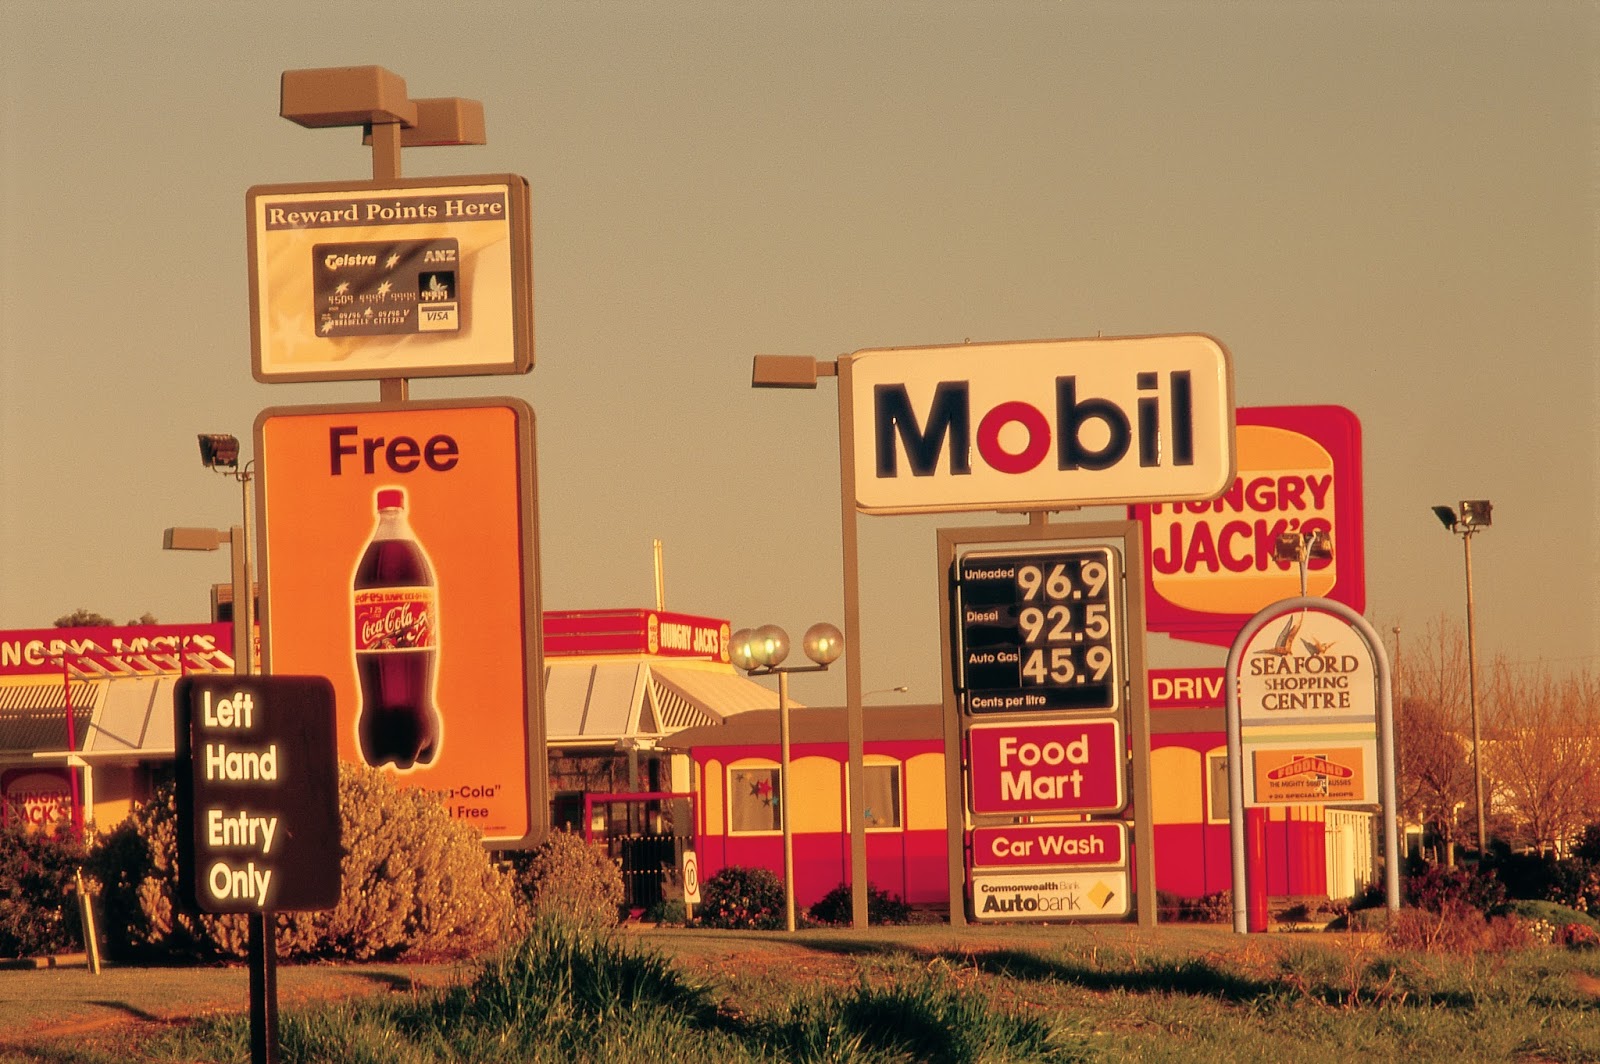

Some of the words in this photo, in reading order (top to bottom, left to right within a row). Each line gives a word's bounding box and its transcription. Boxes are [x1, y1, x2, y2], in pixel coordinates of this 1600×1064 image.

[269, 206, 359, 225] Reward
[366, 202, 437, 220] Points
[445, 199, 502, 217] Here
[324, 253, 377, 271] Telstra
[424, 249, 457, 262] ANZ
[426, 311, 449, 322] VISA
[873, 369, 1195, 479] Mobil
[329, 425, 460, 476] Free
[1151, 474, 1332, 515] NGRY
[964, 568, 1014, 580] Unleaded
[1017, 560, 1107, 600] 96.9
[966, 611, 999, 622] Diesel
[1019, 604, 1109, 643] 92.5
[660, 622, 692, 651] HUNGRY
[969, 653, 995, 664] Auto
[997, 651, 1019, 662] Gas
[1022, 645, 1112, 684] 45.9
[1250, 654, 1359, 677] SEAFORD
[1152, 676, 1241, 700] DRIV
[1264, 675, 1349, 691] SHOPPING
[203, 690, 254, 728] Left
[971, 697, 1004, 708] Cents
[1005, 697, 1023, 709] per
[1025, 695, 1047, 706] litre
[1261, 690, 1351, 711] CENTRE
[206, 744, 278, 780] Hand
[999, 734, 1089, 767] Food
[1277, 758, 1344, 778] FOODLAND
[1000, 769, 1084, 801] Mart
[1269, 780, 1280, 789] THE
[1281, 779, 1305, 788] MIGHTY
[1328, 778, 1352, 787] AUSSIES
[1328, 790, 1354, 798] SHOPS
[19, 804, 68, 825] ACK'S
[457, 805, 489, 818] Free
[208, 809, 278, 854] Entry
[991, 836, 1034, 857] Car
[1038, 834, 1105, 856] Wash
[209, 862, 272, 907] Only
[687, 868, 696, 887] 10
[981, 882, 1059, 893] Commonwealth
[1060, 881, 1080, 890] Bank
[982, 891, 1082, 913] Autobank
